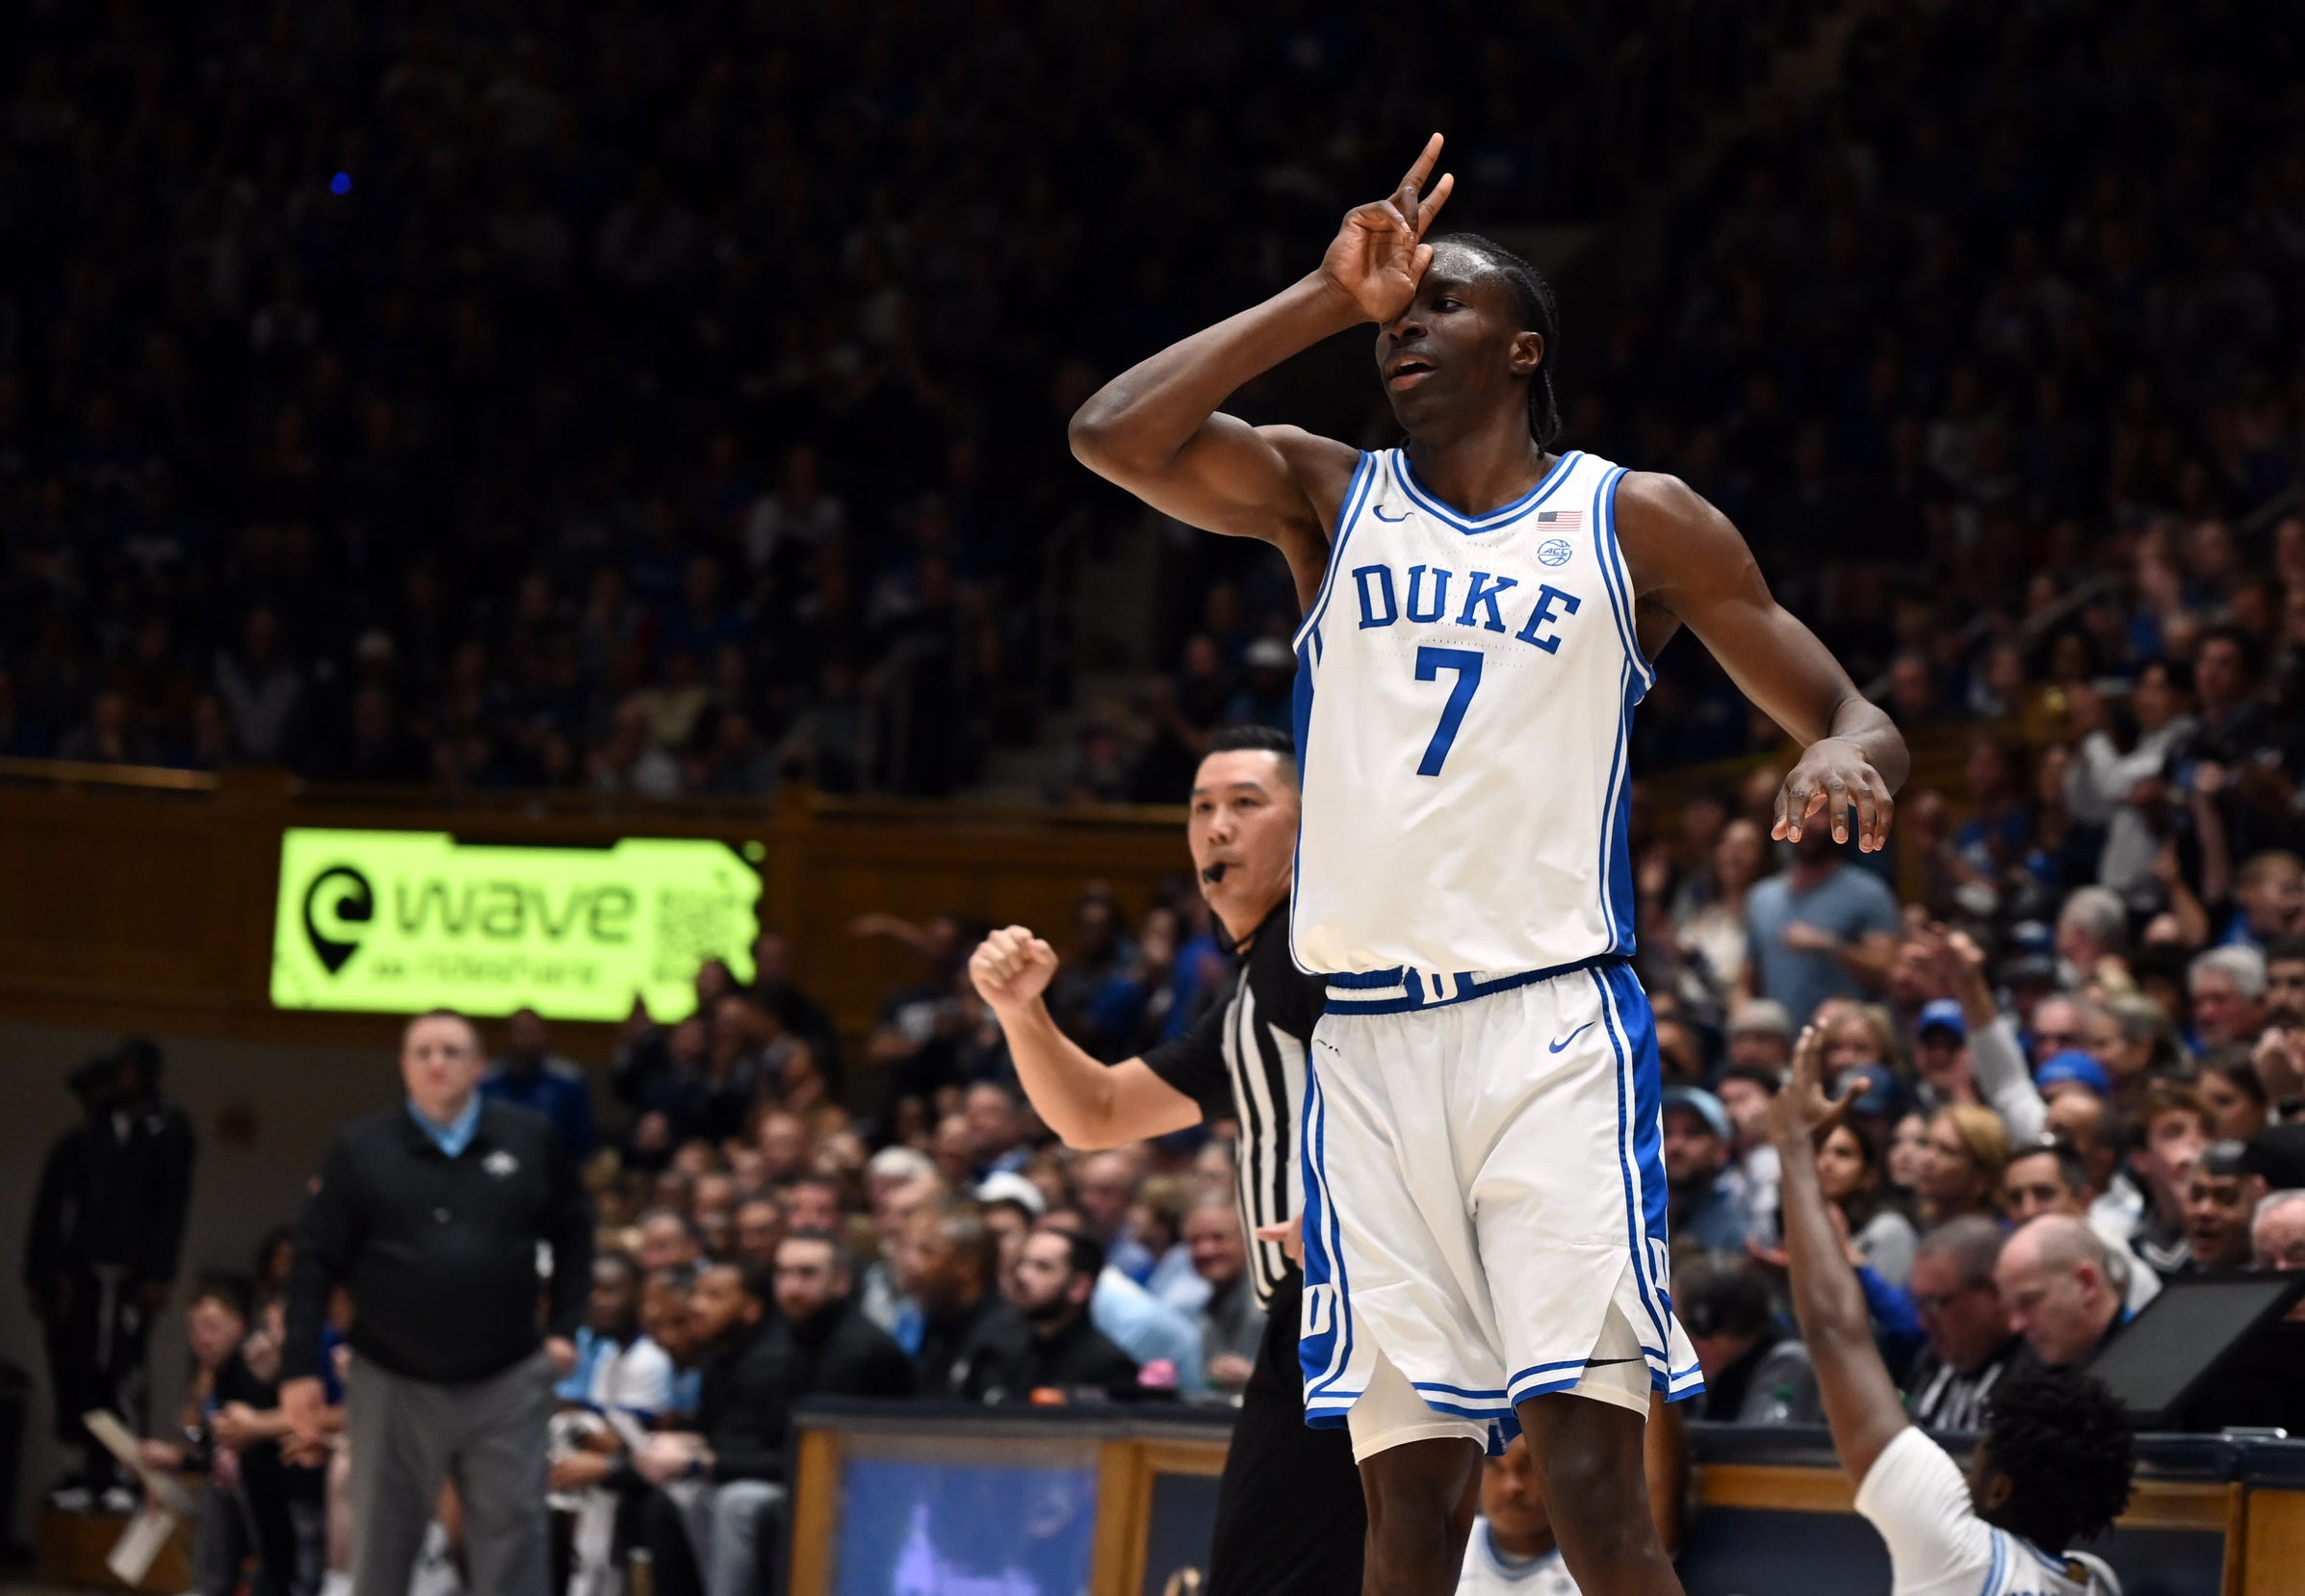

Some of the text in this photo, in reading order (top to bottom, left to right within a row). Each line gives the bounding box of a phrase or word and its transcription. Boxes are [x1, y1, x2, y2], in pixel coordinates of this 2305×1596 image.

[1543, 548, 1570, 556] ACC
[1352, 564, 1581, 655] DUKE
[1415, 646, 1484, 777] 7
[395, 880, 636, 943] wave
